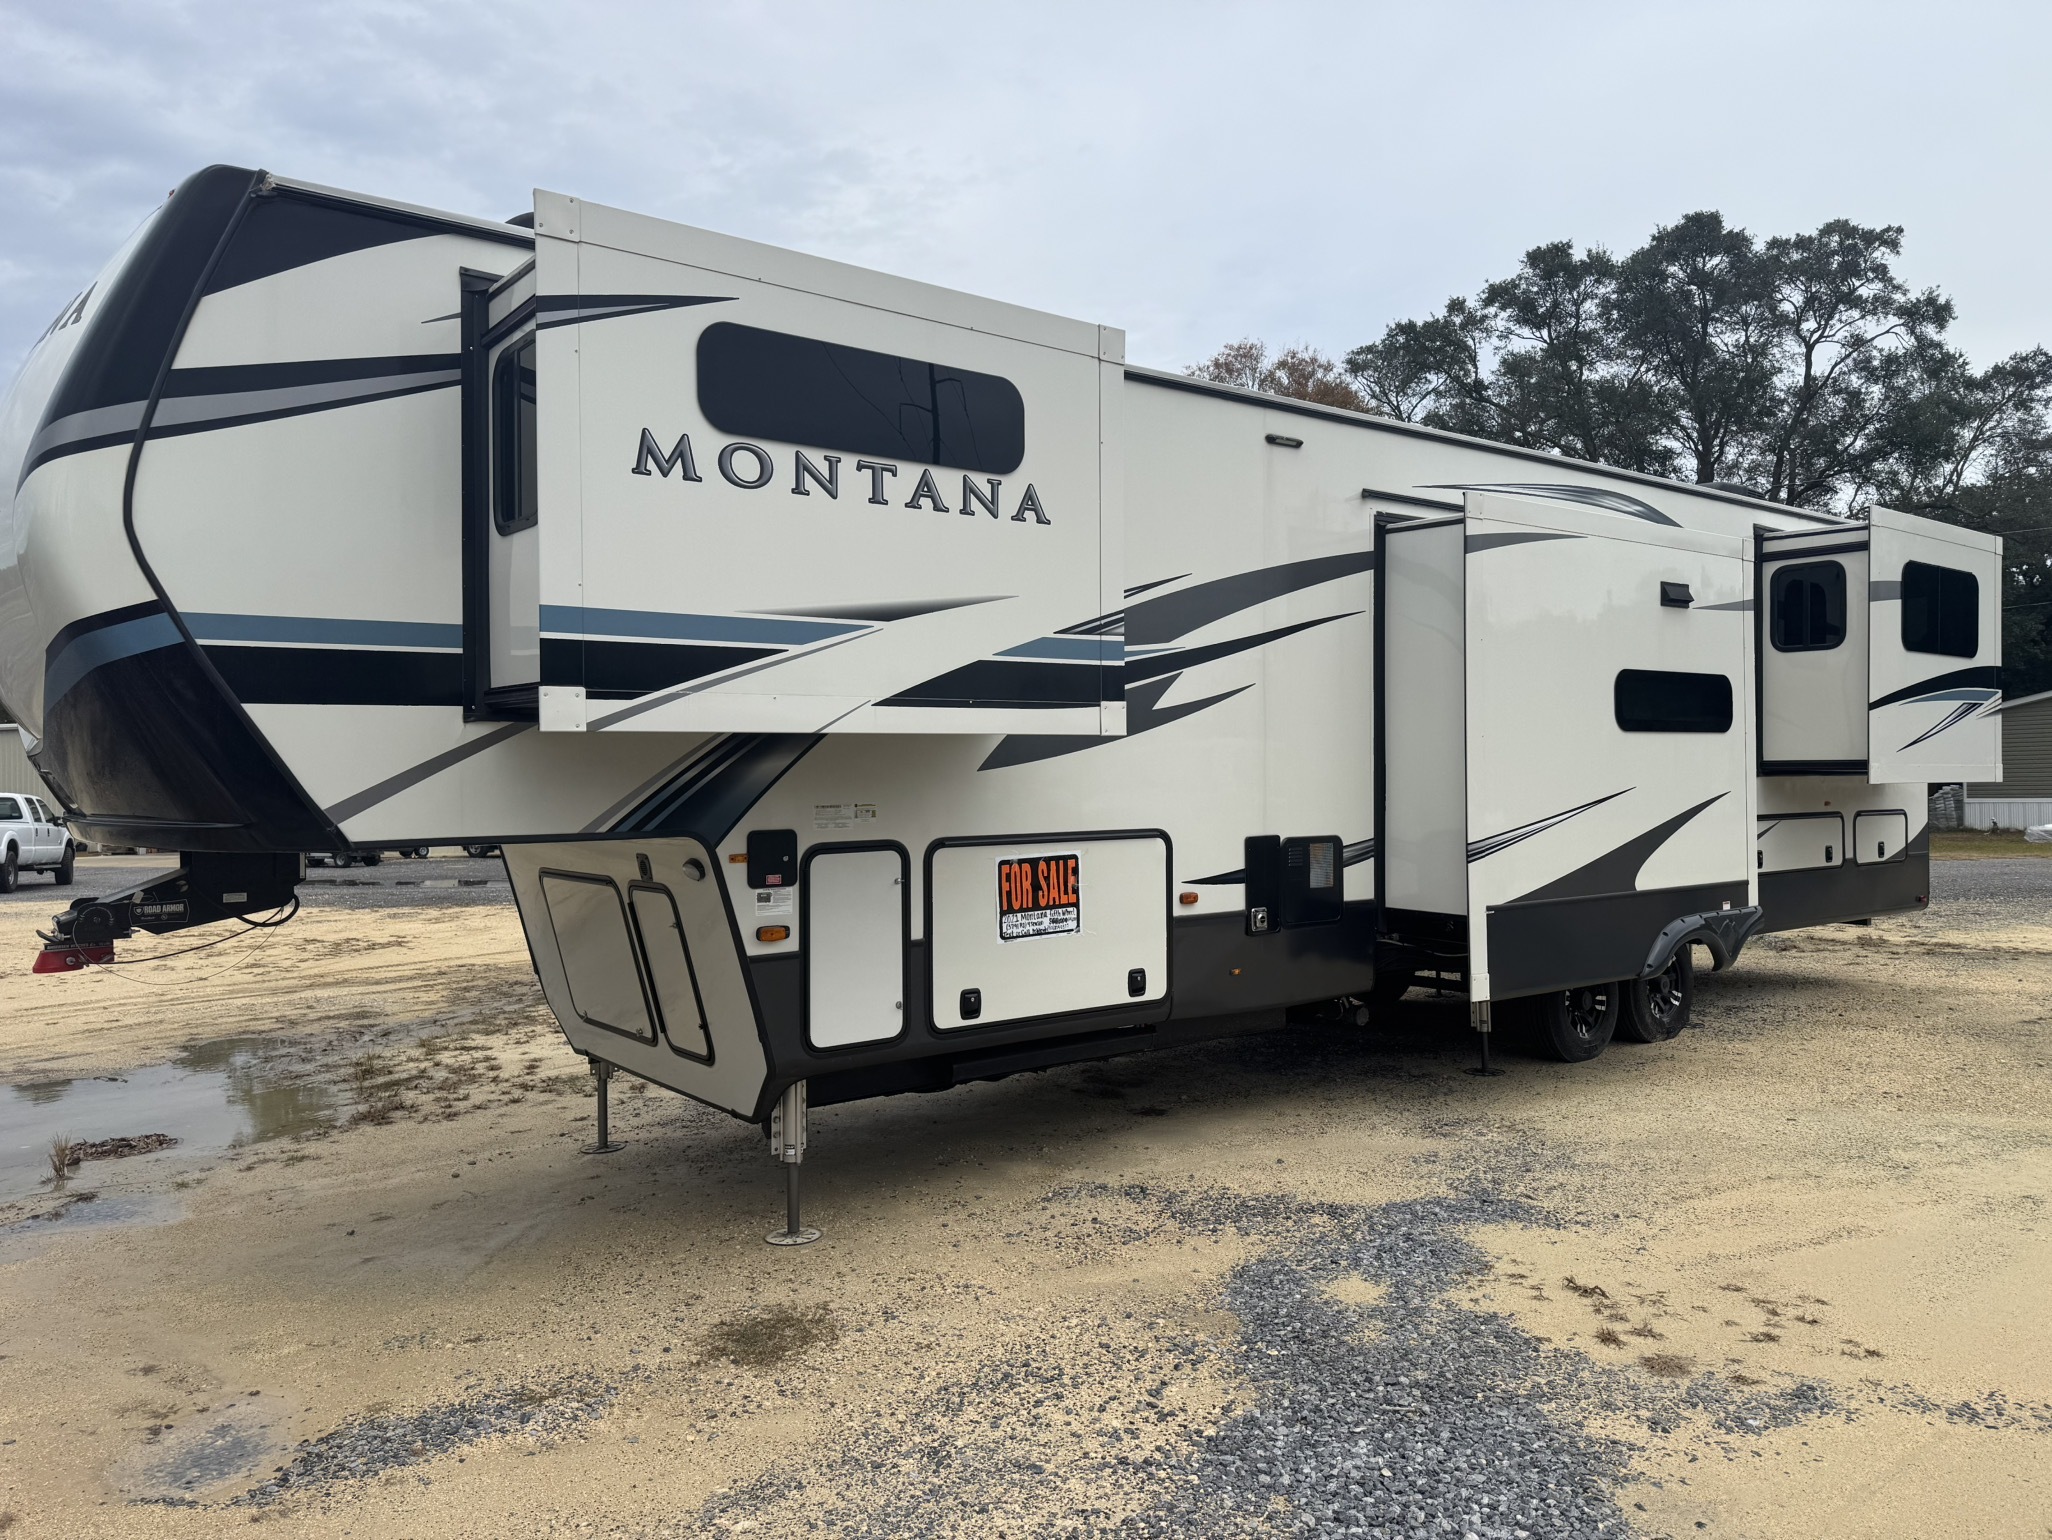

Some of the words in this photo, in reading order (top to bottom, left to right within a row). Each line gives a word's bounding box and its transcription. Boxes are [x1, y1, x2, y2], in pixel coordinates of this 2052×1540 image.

[631, 427, 1052, 525] MONTANA
[1001, 863, 1033, 911] FOR
[1038, 859, 1077, 907] SALE
[143, 905, 162, 914] ROAD
[162, 903, 185, 913] ARMOR
[1021, 912, 1048, 921] Montana
